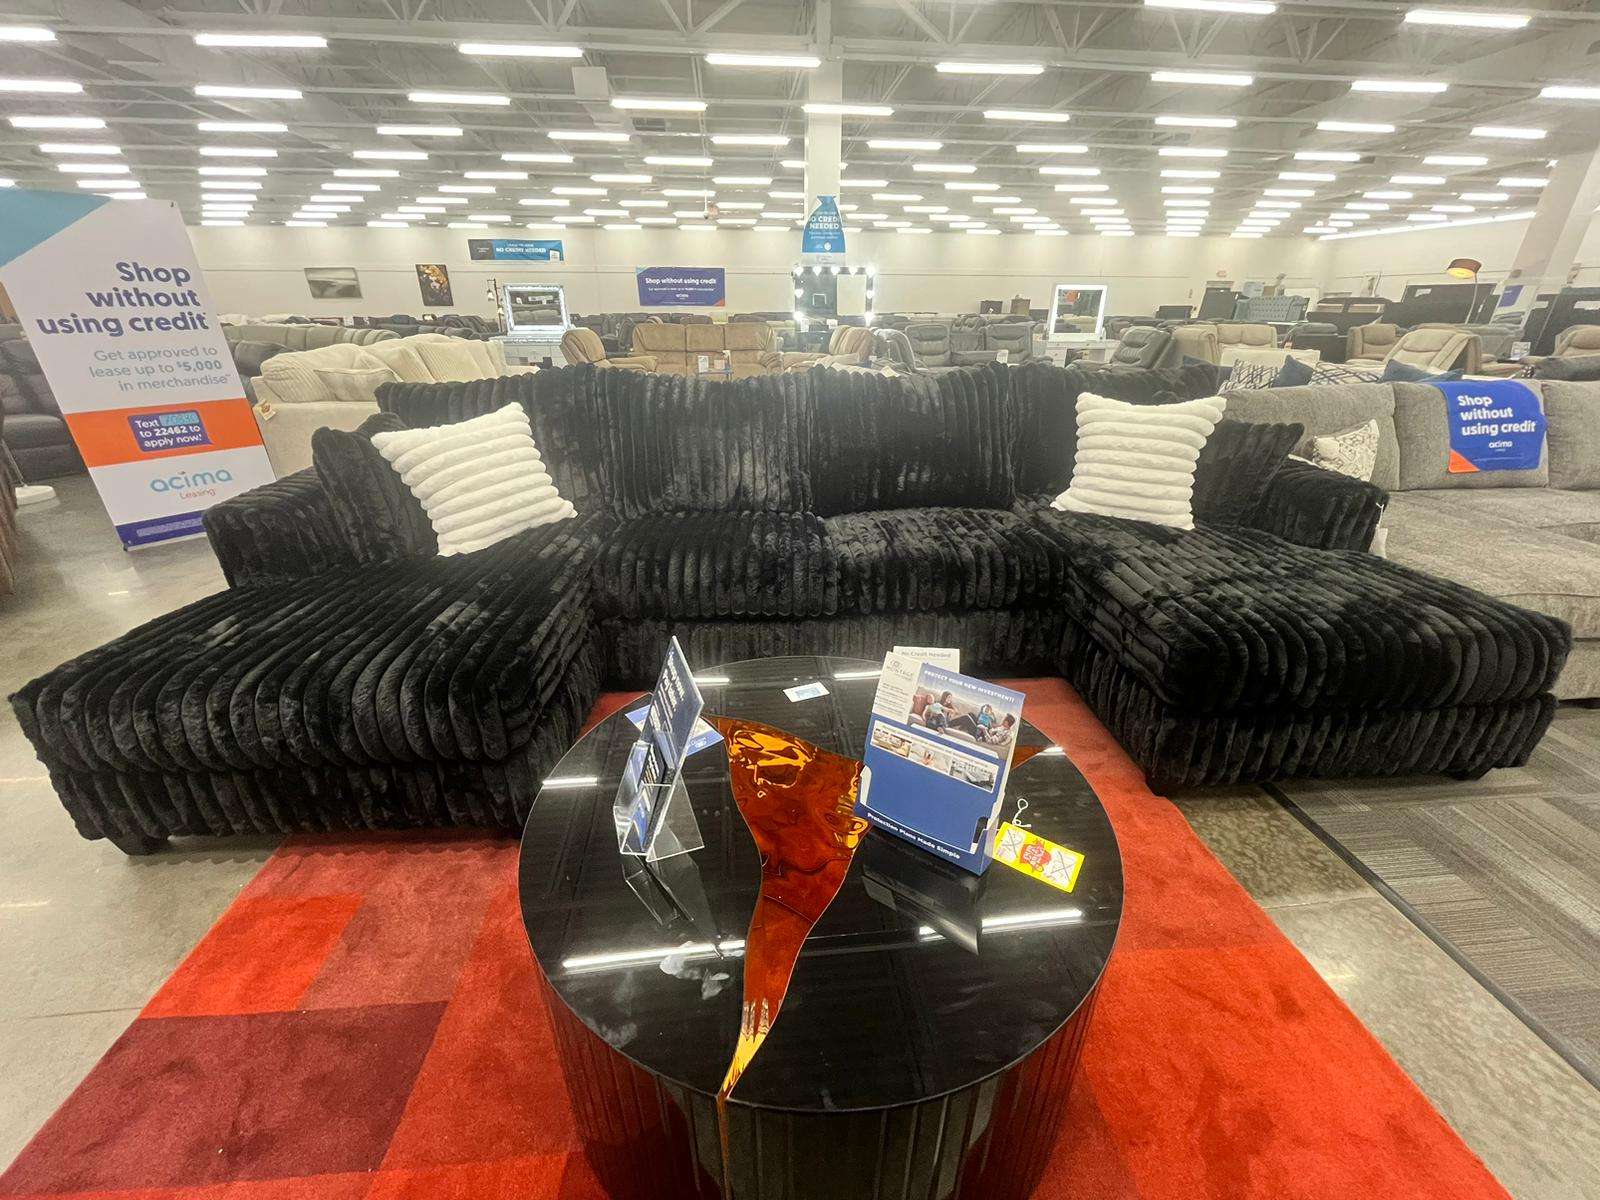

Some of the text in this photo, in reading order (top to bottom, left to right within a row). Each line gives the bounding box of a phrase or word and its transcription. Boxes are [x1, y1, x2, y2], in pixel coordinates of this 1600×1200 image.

[115, 261, 191, 287] Shop
[86, 287, 201, 308] without
[35, 311, 209, 337] using credit
[94, 345, 218, 363] Get approved to
[89, 359, 222, 378] lease up to $5,000
[119, 380, 135, 392] in
[1457, 395, 1493, 407] Shop
[1460, 407, 1514, 421] without
[134, 420, 160, 428] Text
[139, 430, 152, 438] to
[154, 426, 188, 436] 22462
[1462, 420, 1537, 437] using credit
[144, 434, 202, 448] apply now!
[1488, 440, 1513, 448] acima
[150, 469, 233, 493] acima
[179, 488, 216, 500] Leasing
[924, 670, 948, 681] PROTECT
[948, 678, 963, 686] YOUR
[964, 682, 977, 690] NEW
[867, 812, 960, 860] Protection Plans Made Simple
